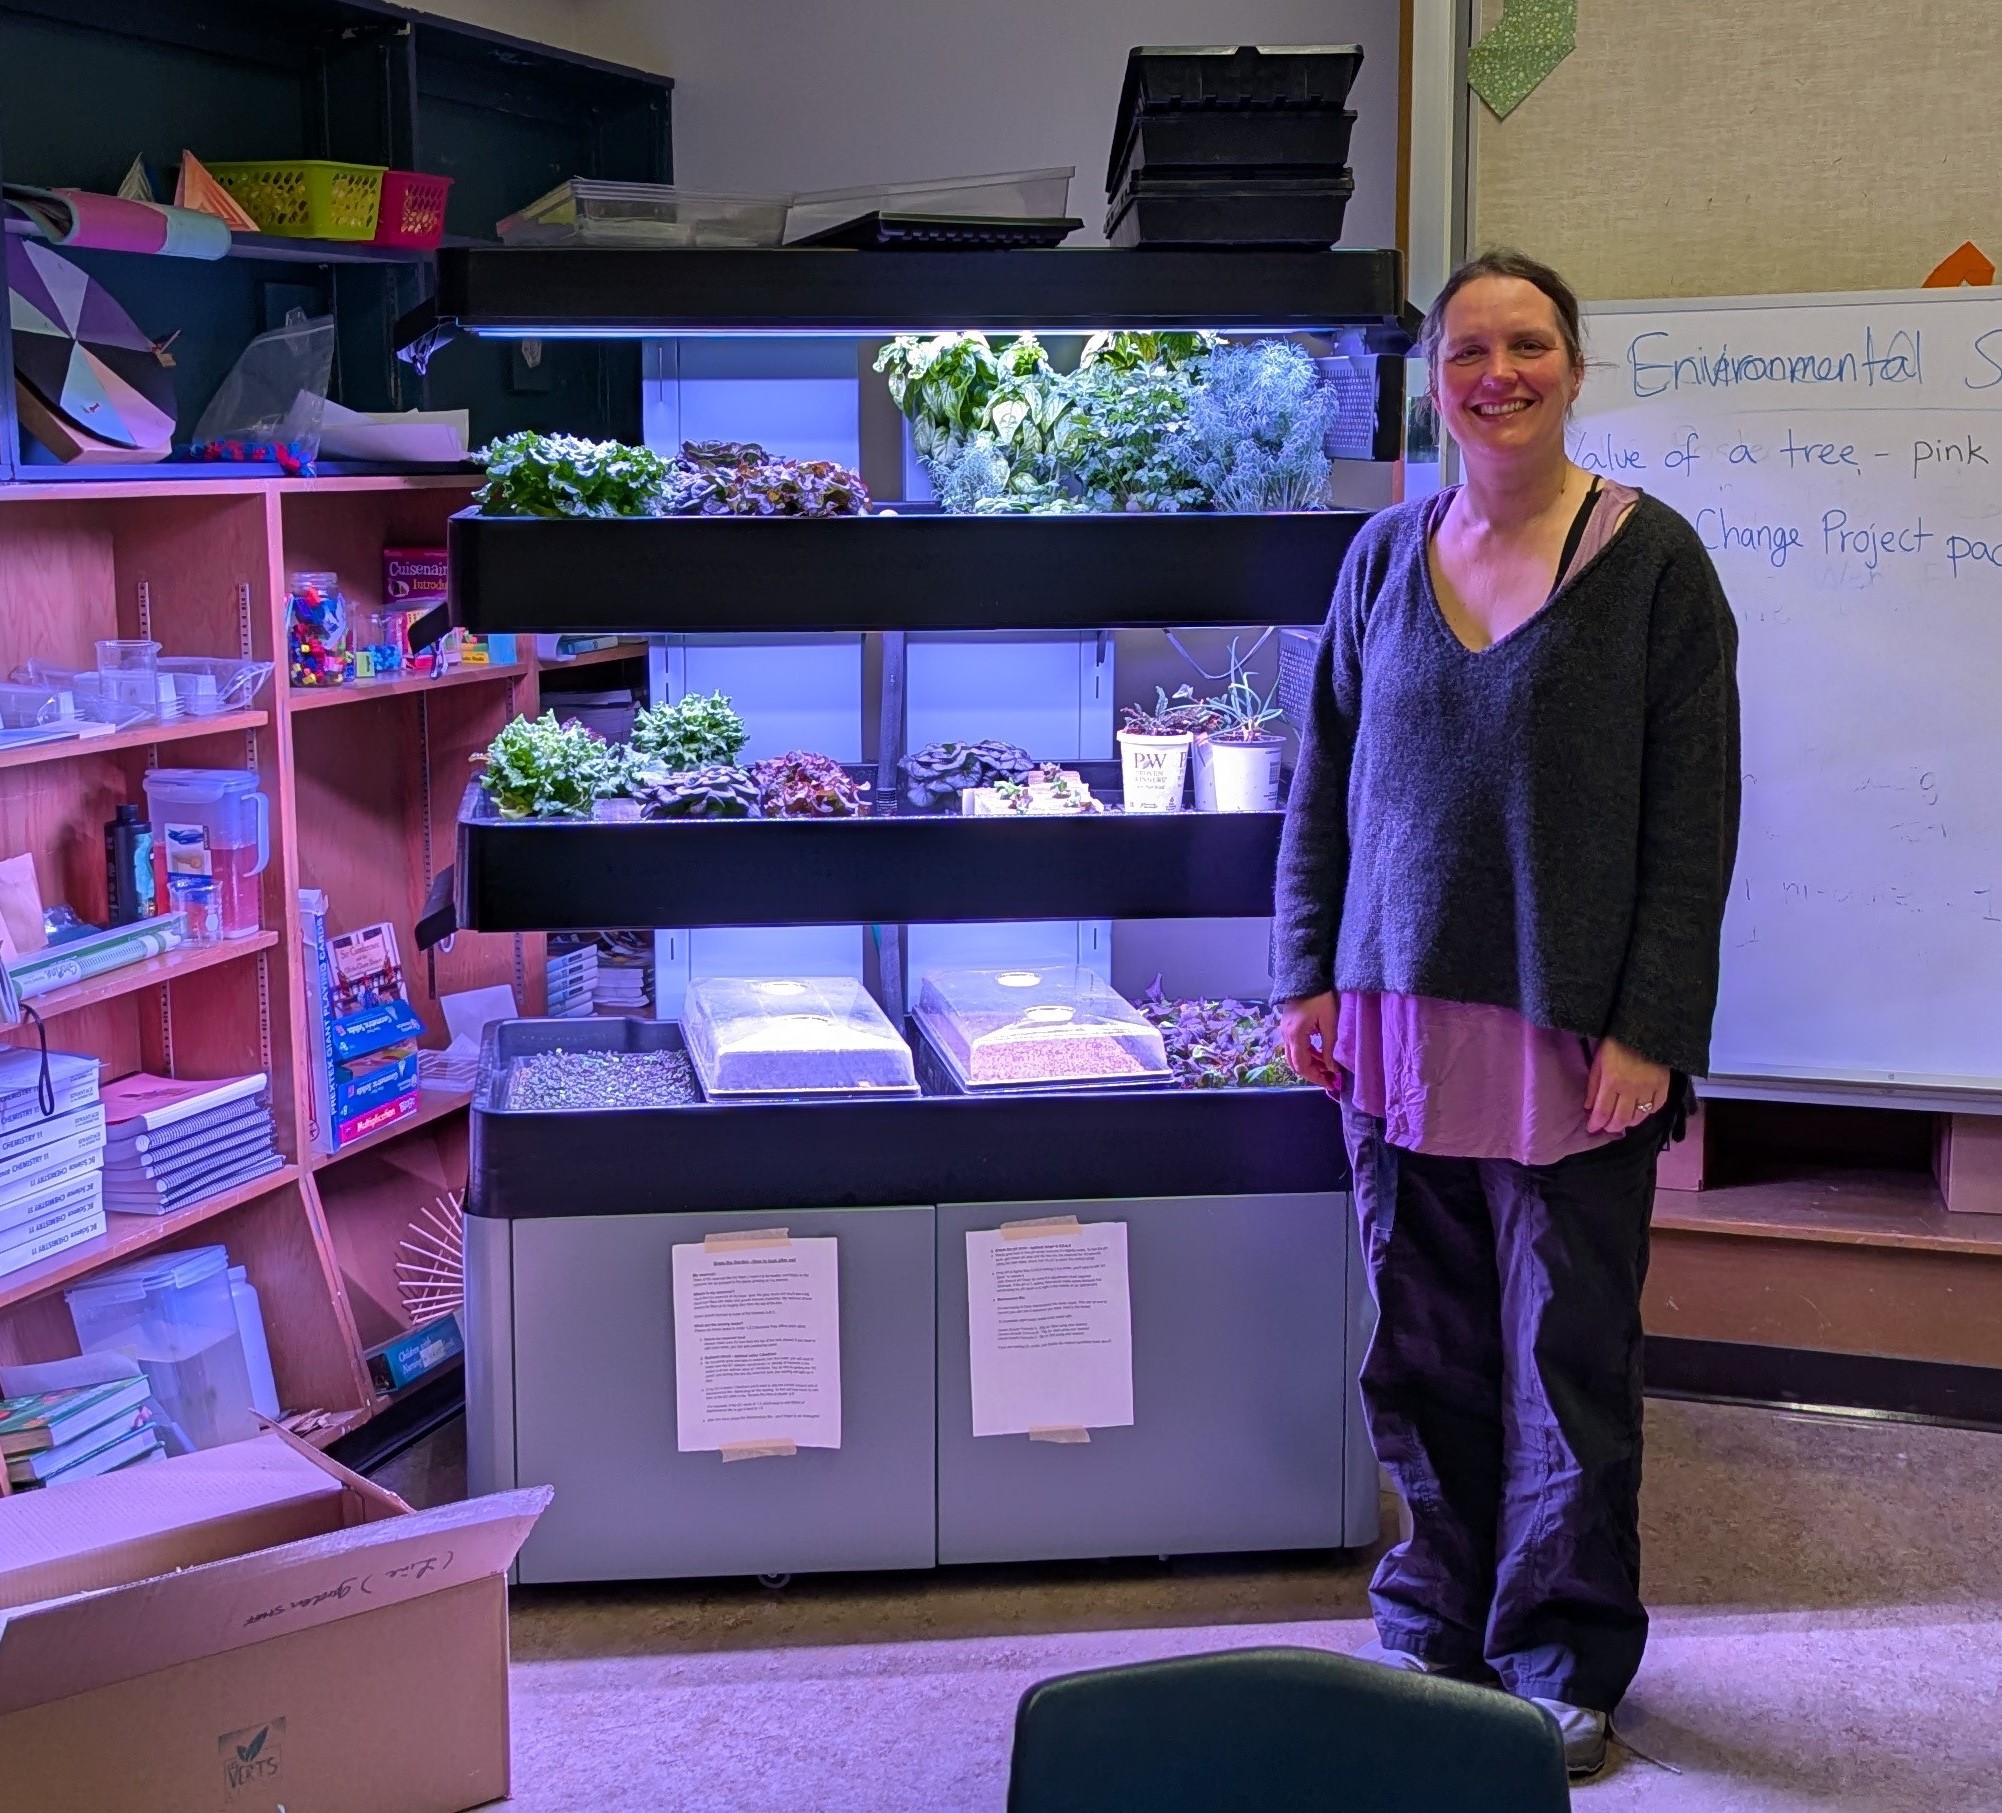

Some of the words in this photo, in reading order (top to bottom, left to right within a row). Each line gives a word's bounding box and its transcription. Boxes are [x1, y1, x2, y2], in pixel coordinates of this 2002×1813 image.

[1664, 432, 1700, 477] of
[1728, 441, 1757, 465] a
[1780, 428, 1859, 470] tree
[1914, 434, 1990, 479] pink
[1696, 508, 1804, 567] Change
[1822, 509, 1934, 569] Project
[316, 917, 326, 960] CARDS
[324, 1020, 333, 1058] GIANT
[2, 1133, 35, 1151] CHEMISTRY
[12, 1156, 42, 1173] CHEMISTRY
[37, 1166, 68, 1185] CHEMISTRY
[34, 1194, 65, 1211] CHEMISTRY
[36, 1213, 66, 1231] CHEMISTRY
[70, 1226, 90, 1238] Science
[38, 1234, 69, 1252] CHEMISTRY
